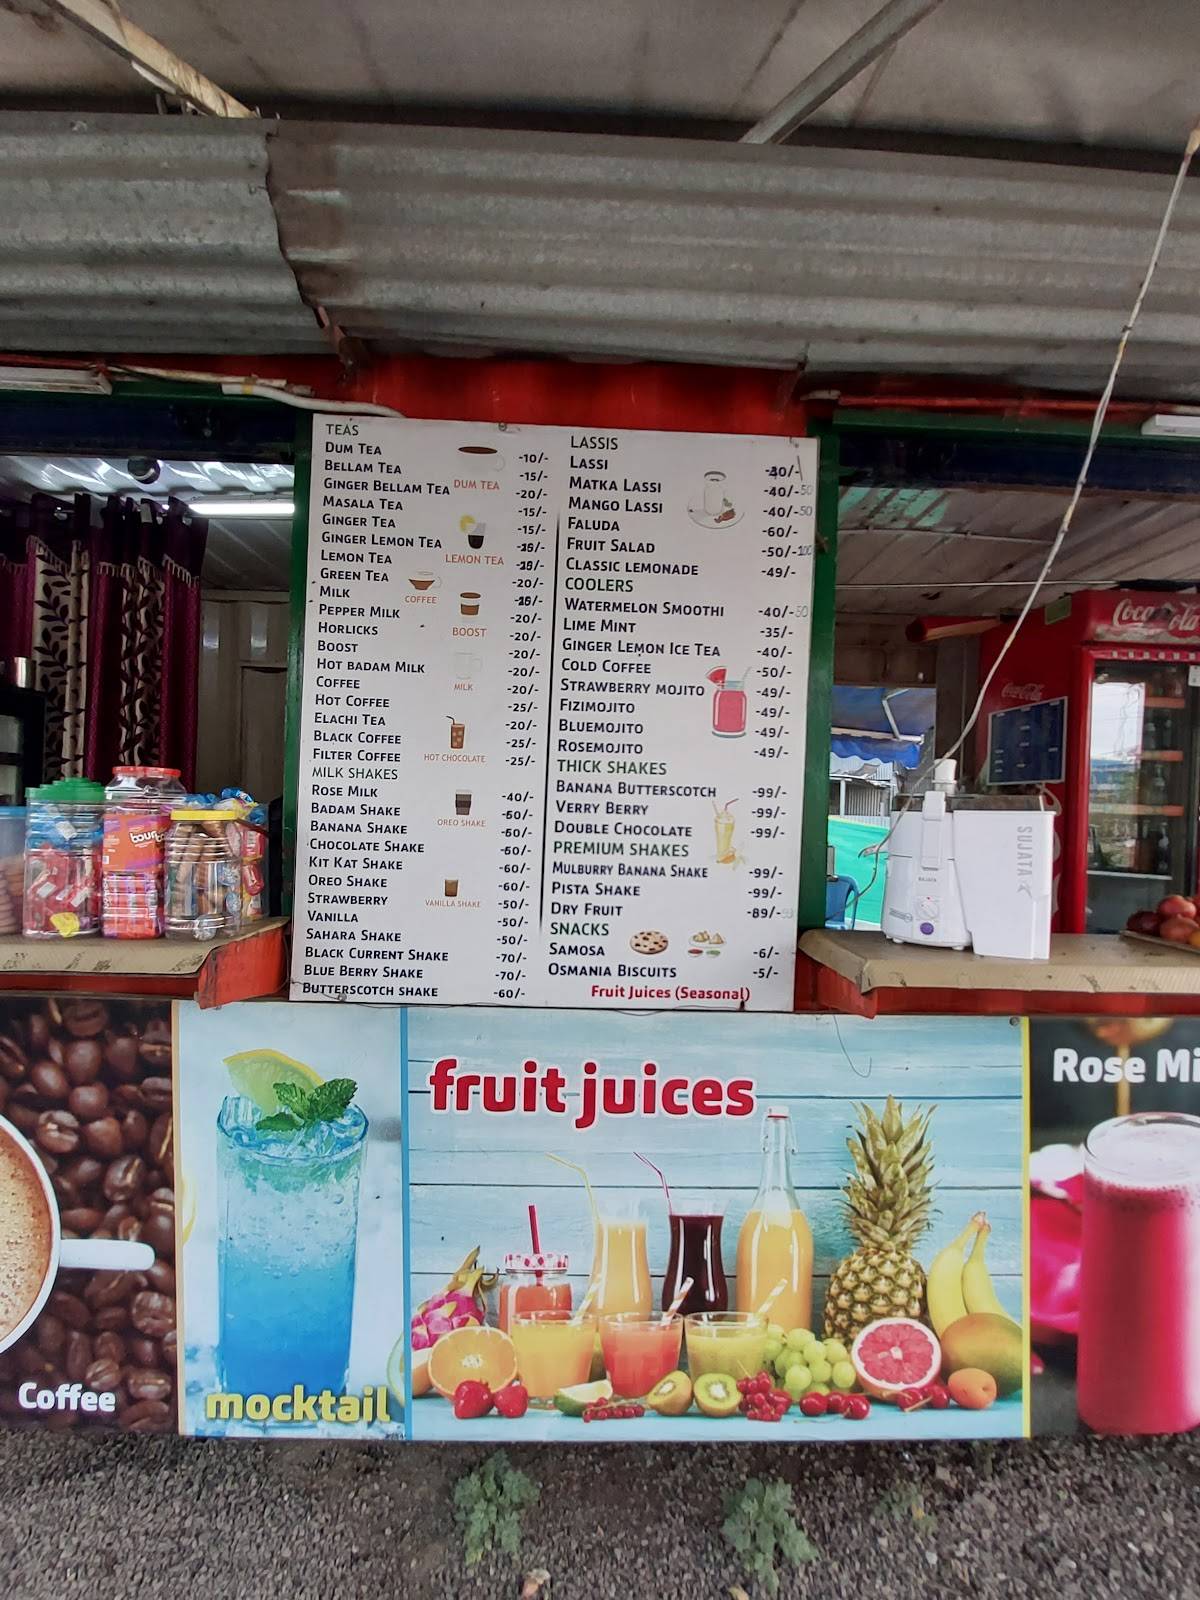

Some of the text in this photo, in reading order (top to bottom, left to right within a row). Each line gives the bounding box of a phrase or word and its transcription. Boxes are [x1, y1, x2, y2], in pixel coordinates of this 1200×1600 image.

[326, 424, 358, 436] TEAS
[571, 436, 618, 450] LASSIS
[454, 480, 500, 490] DUM TEA
[446, 554, 504, 565] LEMON TEA
[566, 577, 633, 592] COOLERS
[405, 596, 437, 604] COFFEE
[453, 627, 487, 637] BOOST
[442, 754, 485, 762] CHOCOLATE
[312, 767, 398, 780] MILK SHAKES
[557, 760, 666, 775] THICK SHAKES
[554, 841, 688, 857] PREMIUM SHAKES
[1017, 826, 1033, 876] SUJATA
[550, 922, 609, 936] SNACKS
[592, 985, 750, 1000] Fruit Juices (Seasonal)
[1053, 1048, 1146, 1083] Rose
[430, 1058, 755, 1129] fruit juices
[18, 1382, 116, 1412] Coffee
[206, 1385, 392, 1423] mocktail
